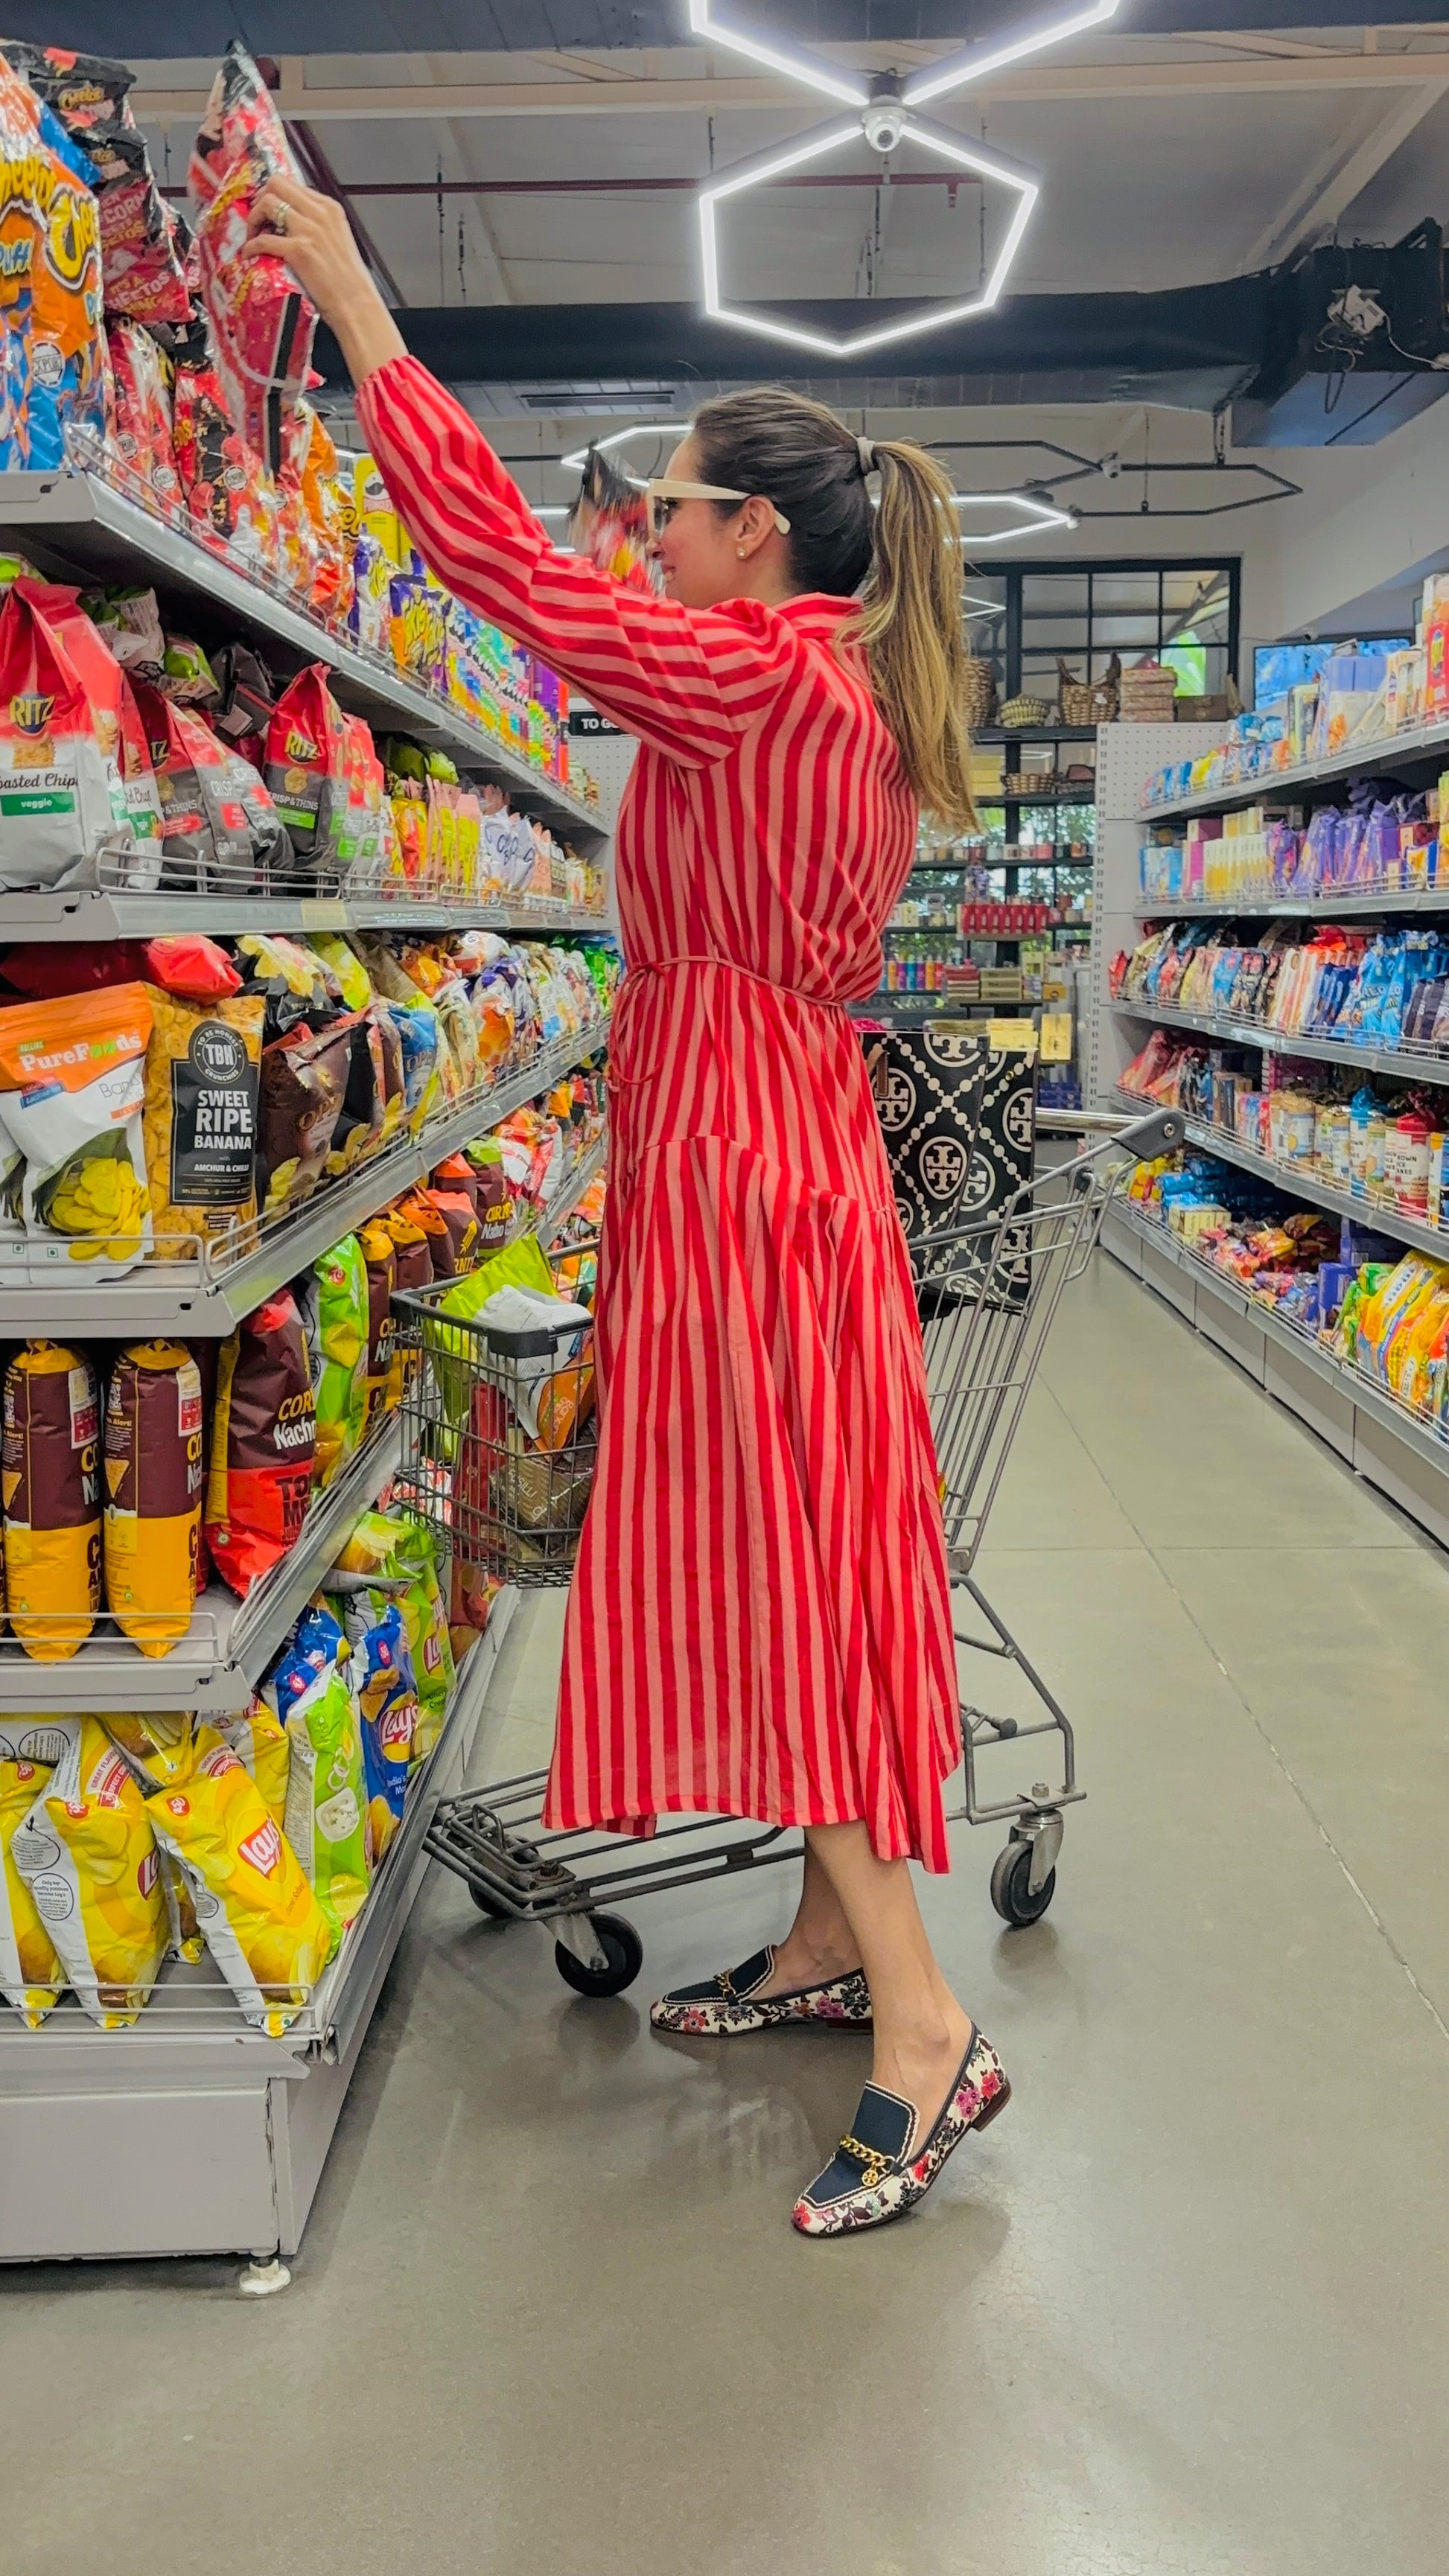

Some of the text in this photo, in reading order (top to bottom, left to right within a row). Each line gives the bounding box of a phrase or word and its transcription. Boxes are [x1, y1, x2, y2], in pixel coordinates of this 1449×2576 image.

[9, 695, 56, 727] RITZ
[581, 718, 599, 730] TO
[284, 727, 319, 761] RITZ
[0, 774, 42, 789] oasted
[21, 798, 53, 809] veggie
[197, 1036, 206, 1046] TO
[205, 1030, 214, 1039] BE
[206, 1043, 235, 1065] TBH
[197, 1089, 249, 1108] SWEET
[195, 1108, 253, 1134] RIPE
[194, 1135, 252, 1150] BANANA
[194, 1164, 225, 1173] AMCHUR
[226, 1164, 232, 1173] &
